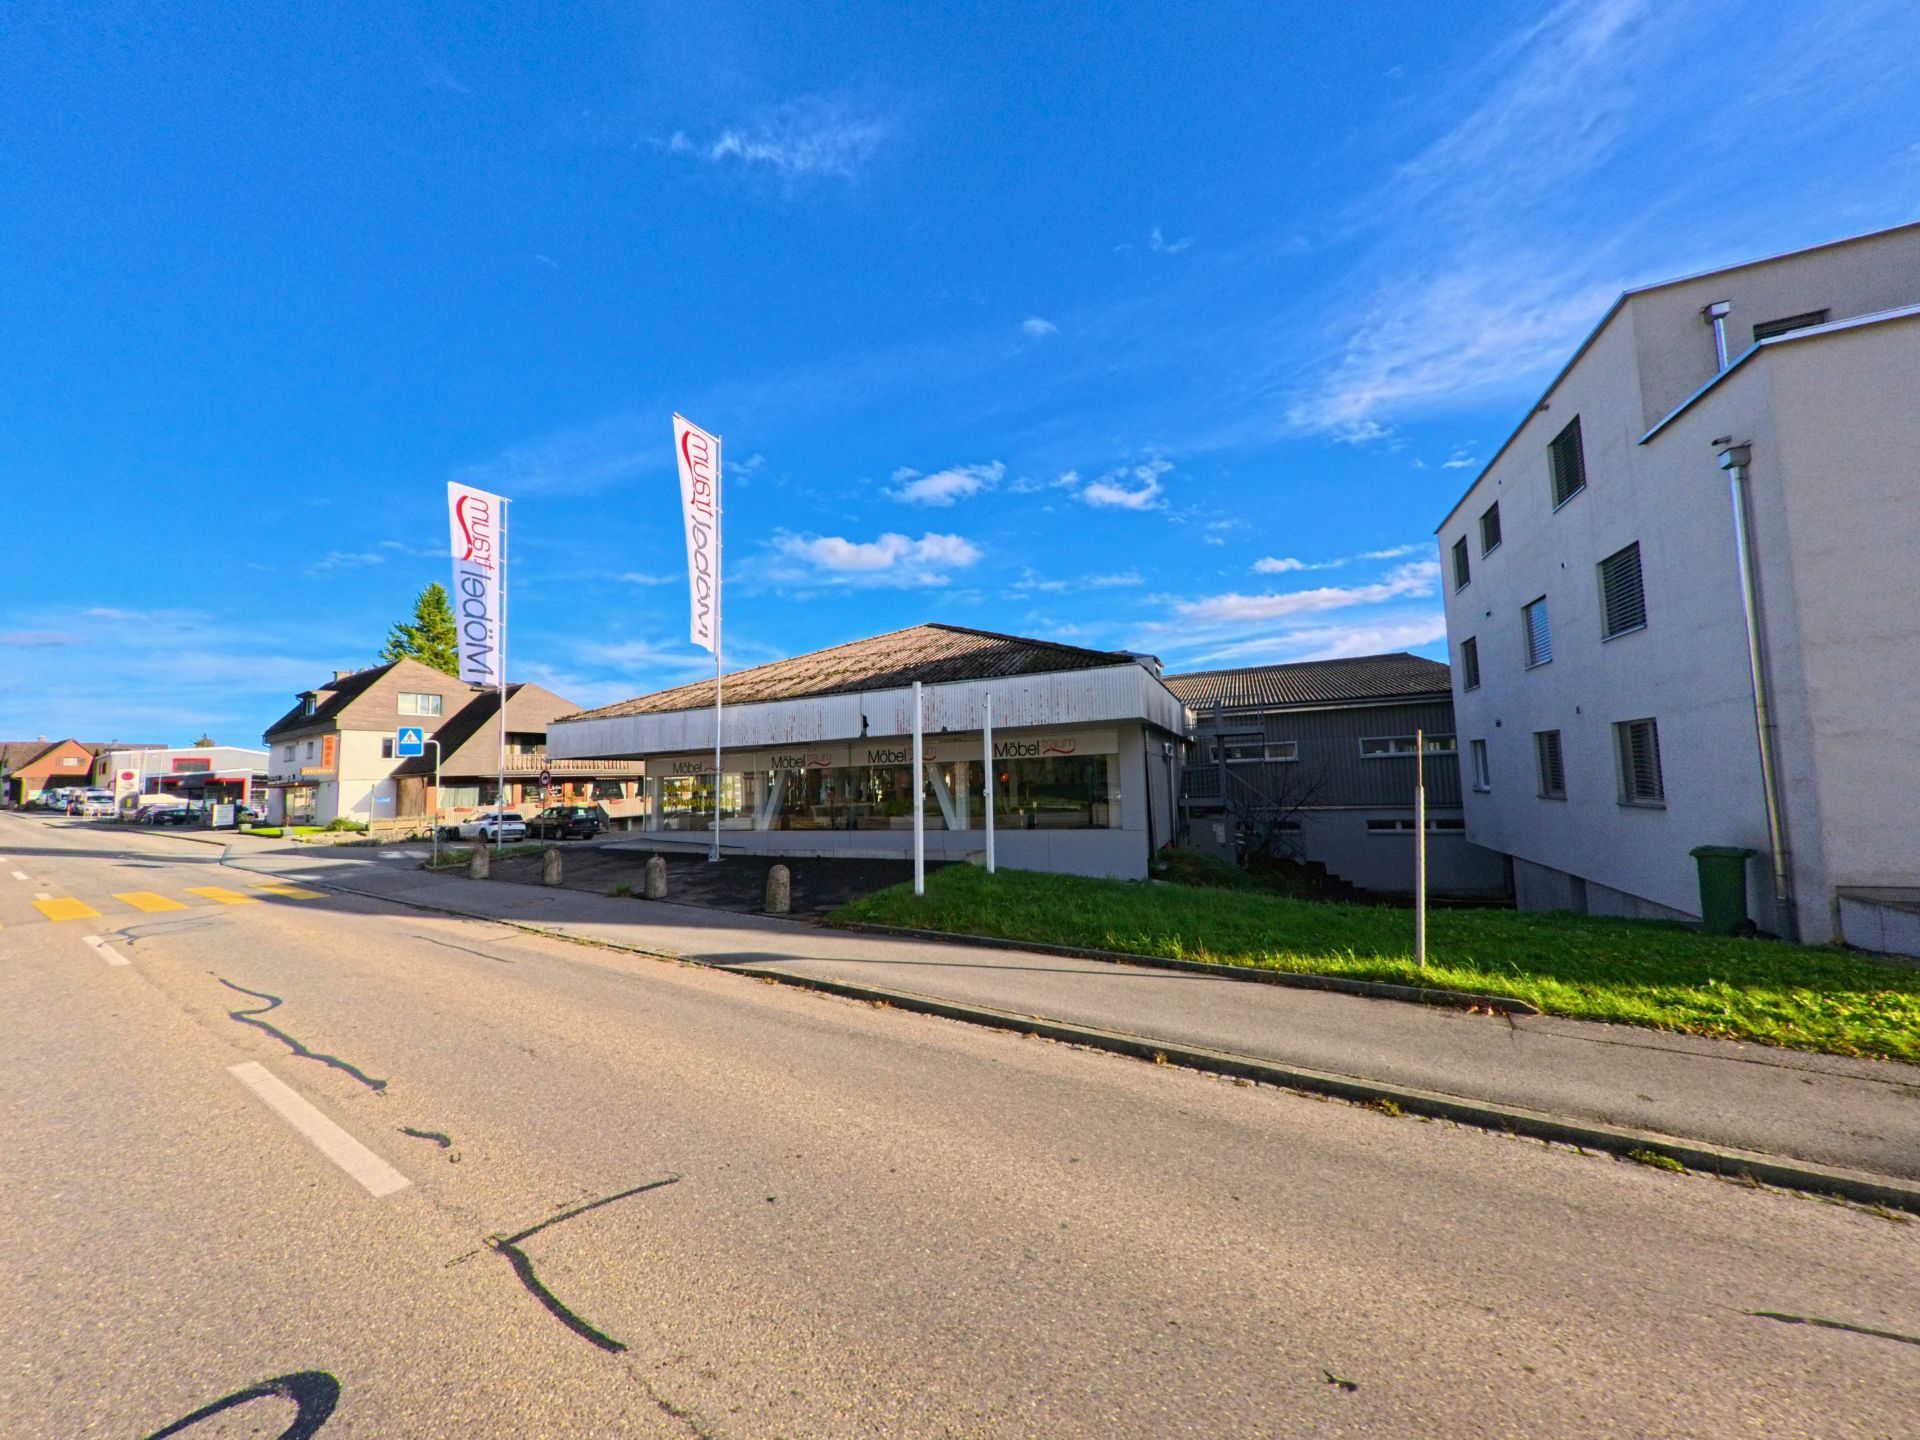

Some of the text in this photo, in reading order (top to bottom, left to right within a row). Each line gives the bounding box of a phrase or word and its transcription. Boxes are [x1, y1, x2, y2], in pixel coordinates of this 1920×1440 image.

[994, 738, 1076, 757] Möbel traum
[771, 754, 806, 769] Möbel
[867, 748, 907, 764] Möbel
[672, 760, 703, 775] Möbel
